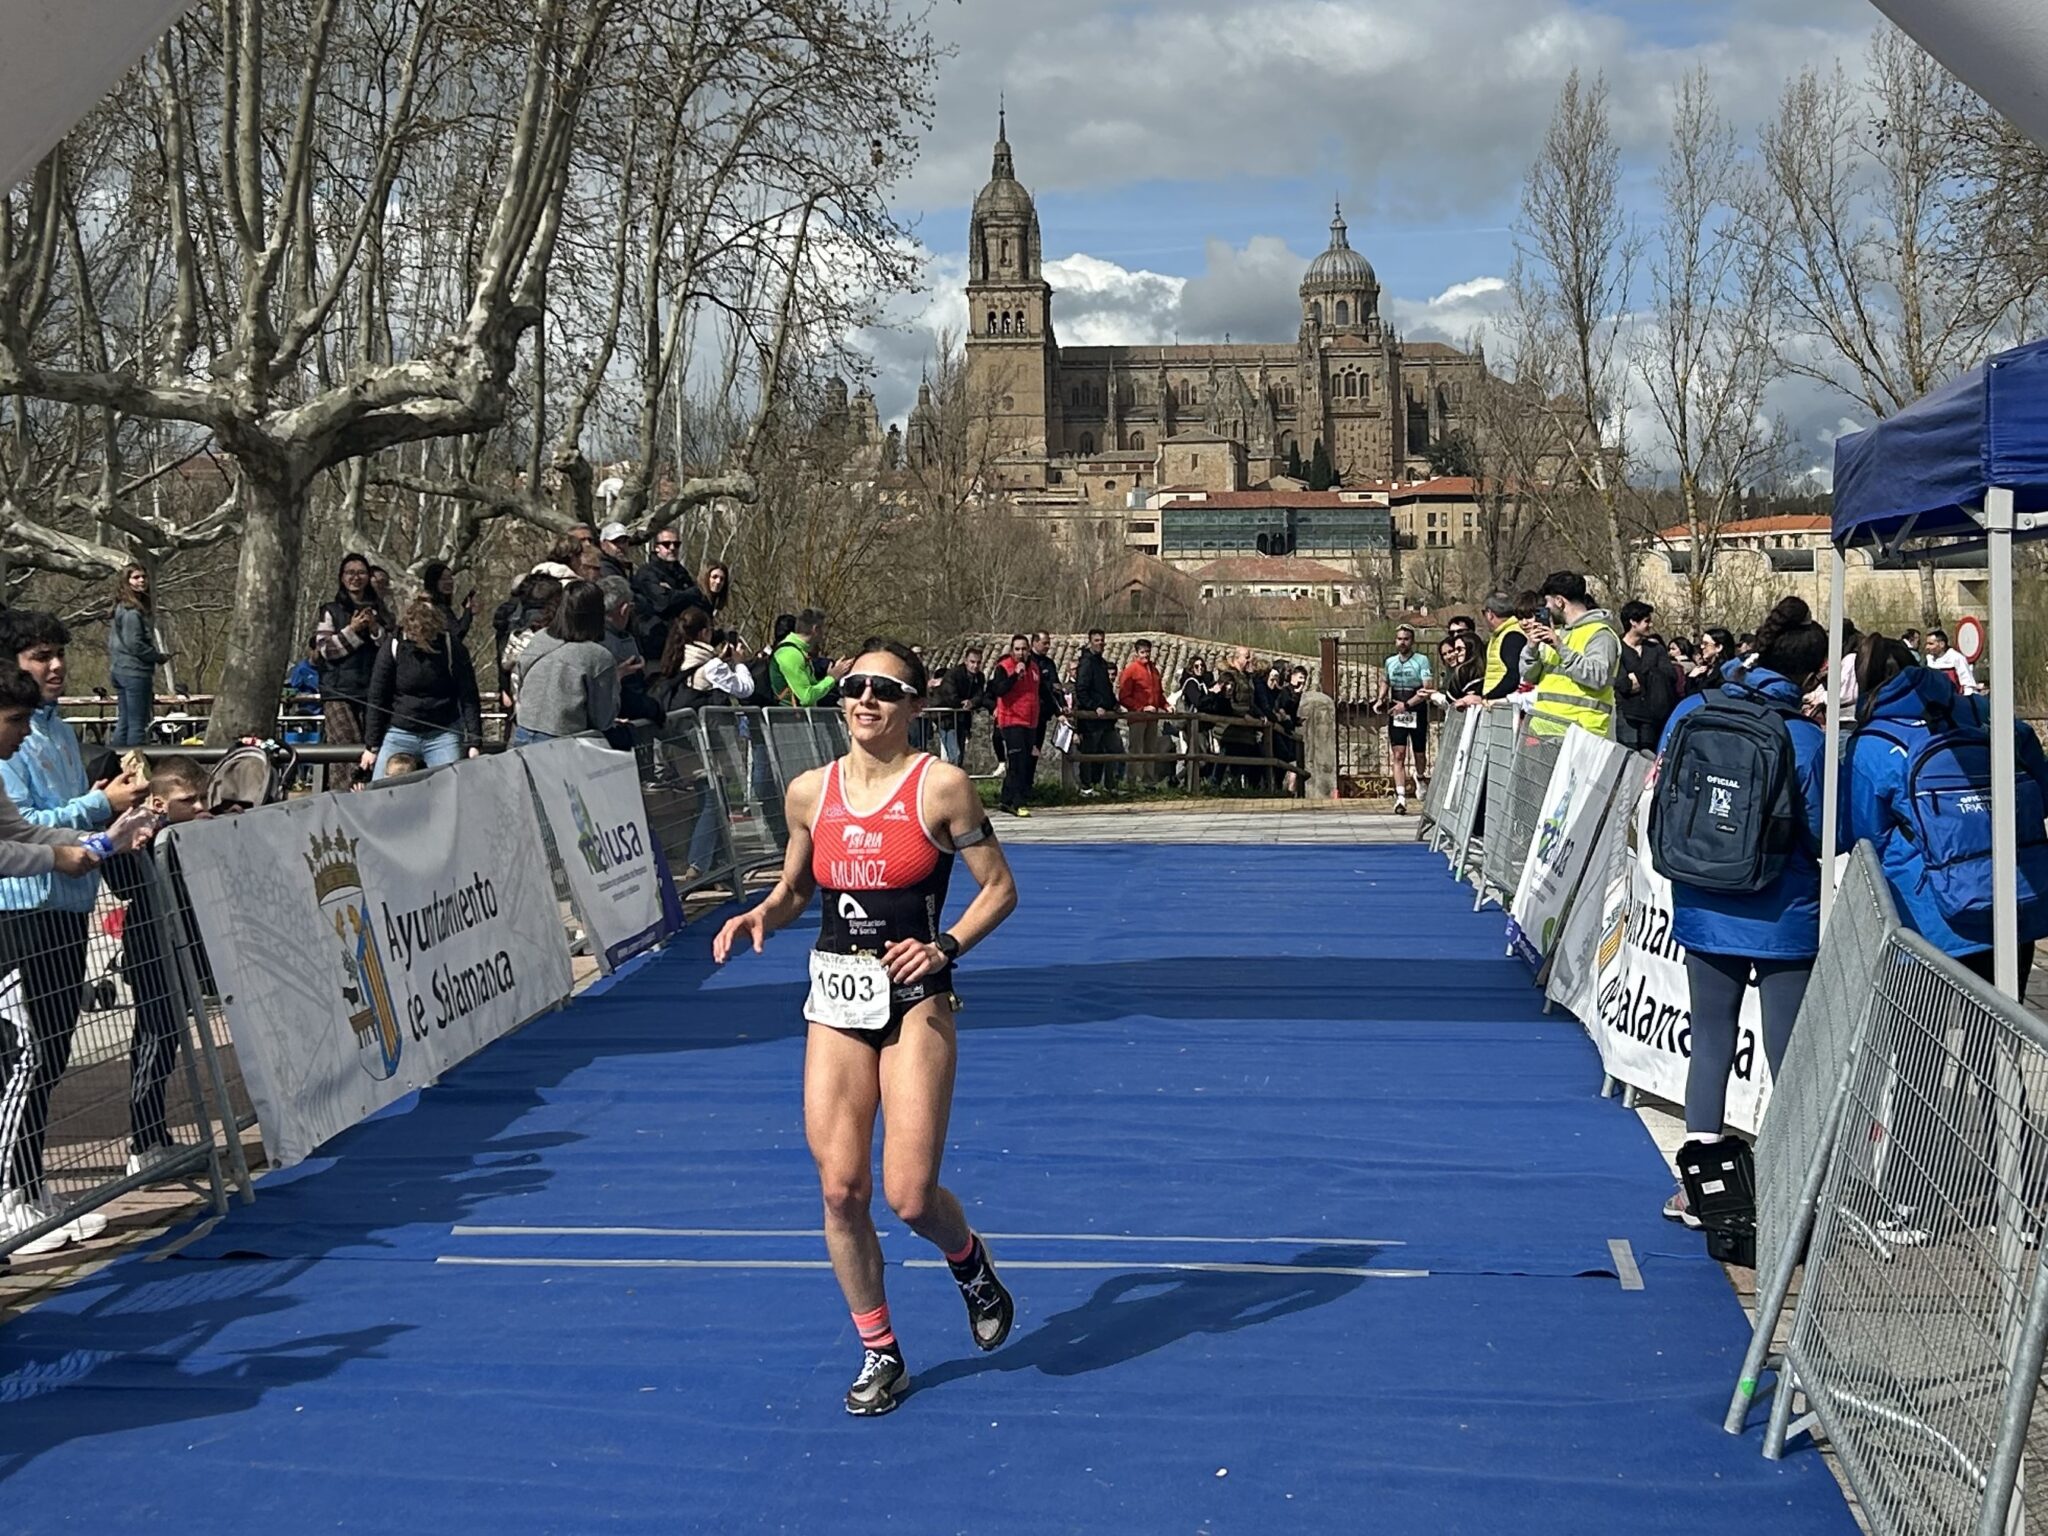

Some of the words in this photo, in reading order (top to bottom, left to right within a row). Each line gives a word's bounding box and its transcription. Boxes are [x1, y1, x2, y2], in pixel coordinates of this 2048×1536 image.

[1707, 775, 1740, 788] OFICIAL
[831, 855, 887, 887] MUÑOZ
[381, 871, 498, 972] Ayuntamiento
[432, 951, 516, 1029] Salamanca
[818, 970, 875, 1002] 1503
